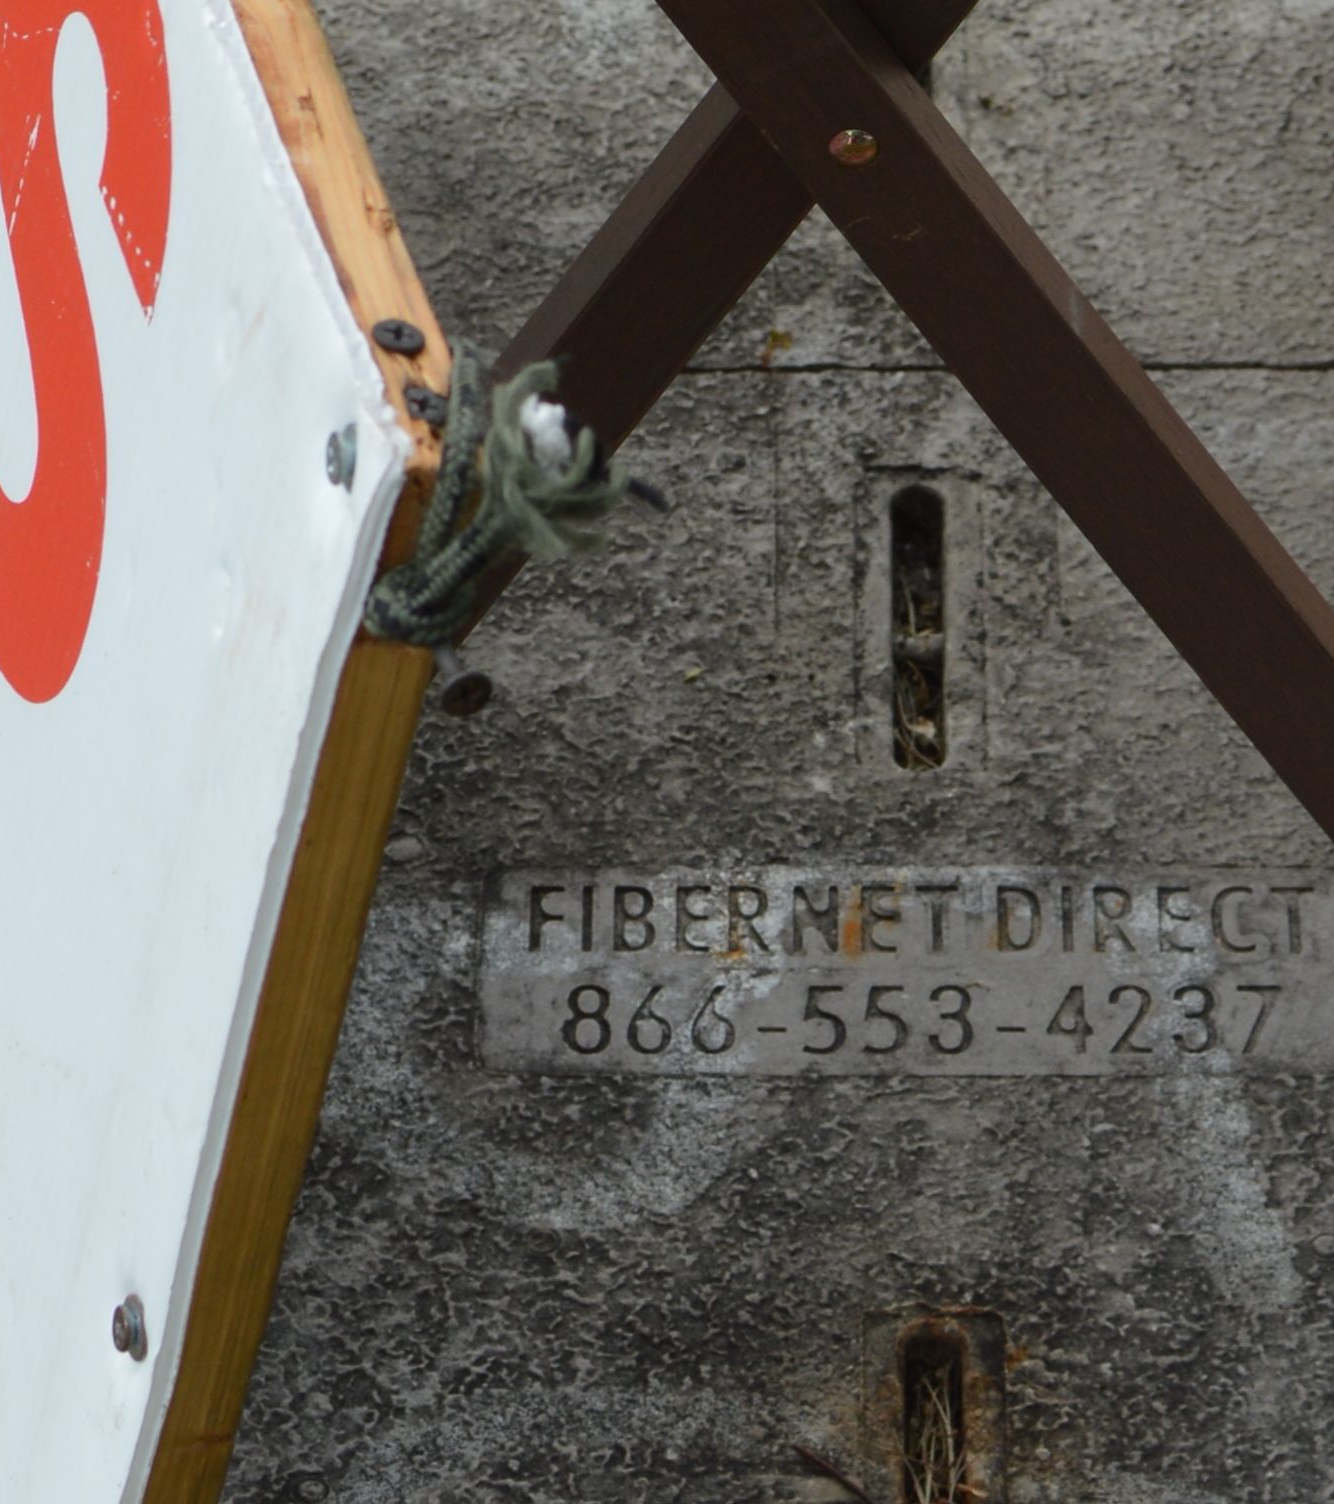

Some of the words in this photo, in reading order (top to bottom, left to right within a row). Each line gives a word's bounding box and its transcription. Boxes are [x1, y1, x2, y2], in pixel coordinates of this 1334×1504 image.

[526, 884, 960, 955] FIBERNET
[993, 884, 1317, 955] DIRECT
[560, 984, 1284, 1057] 866-553-4237
